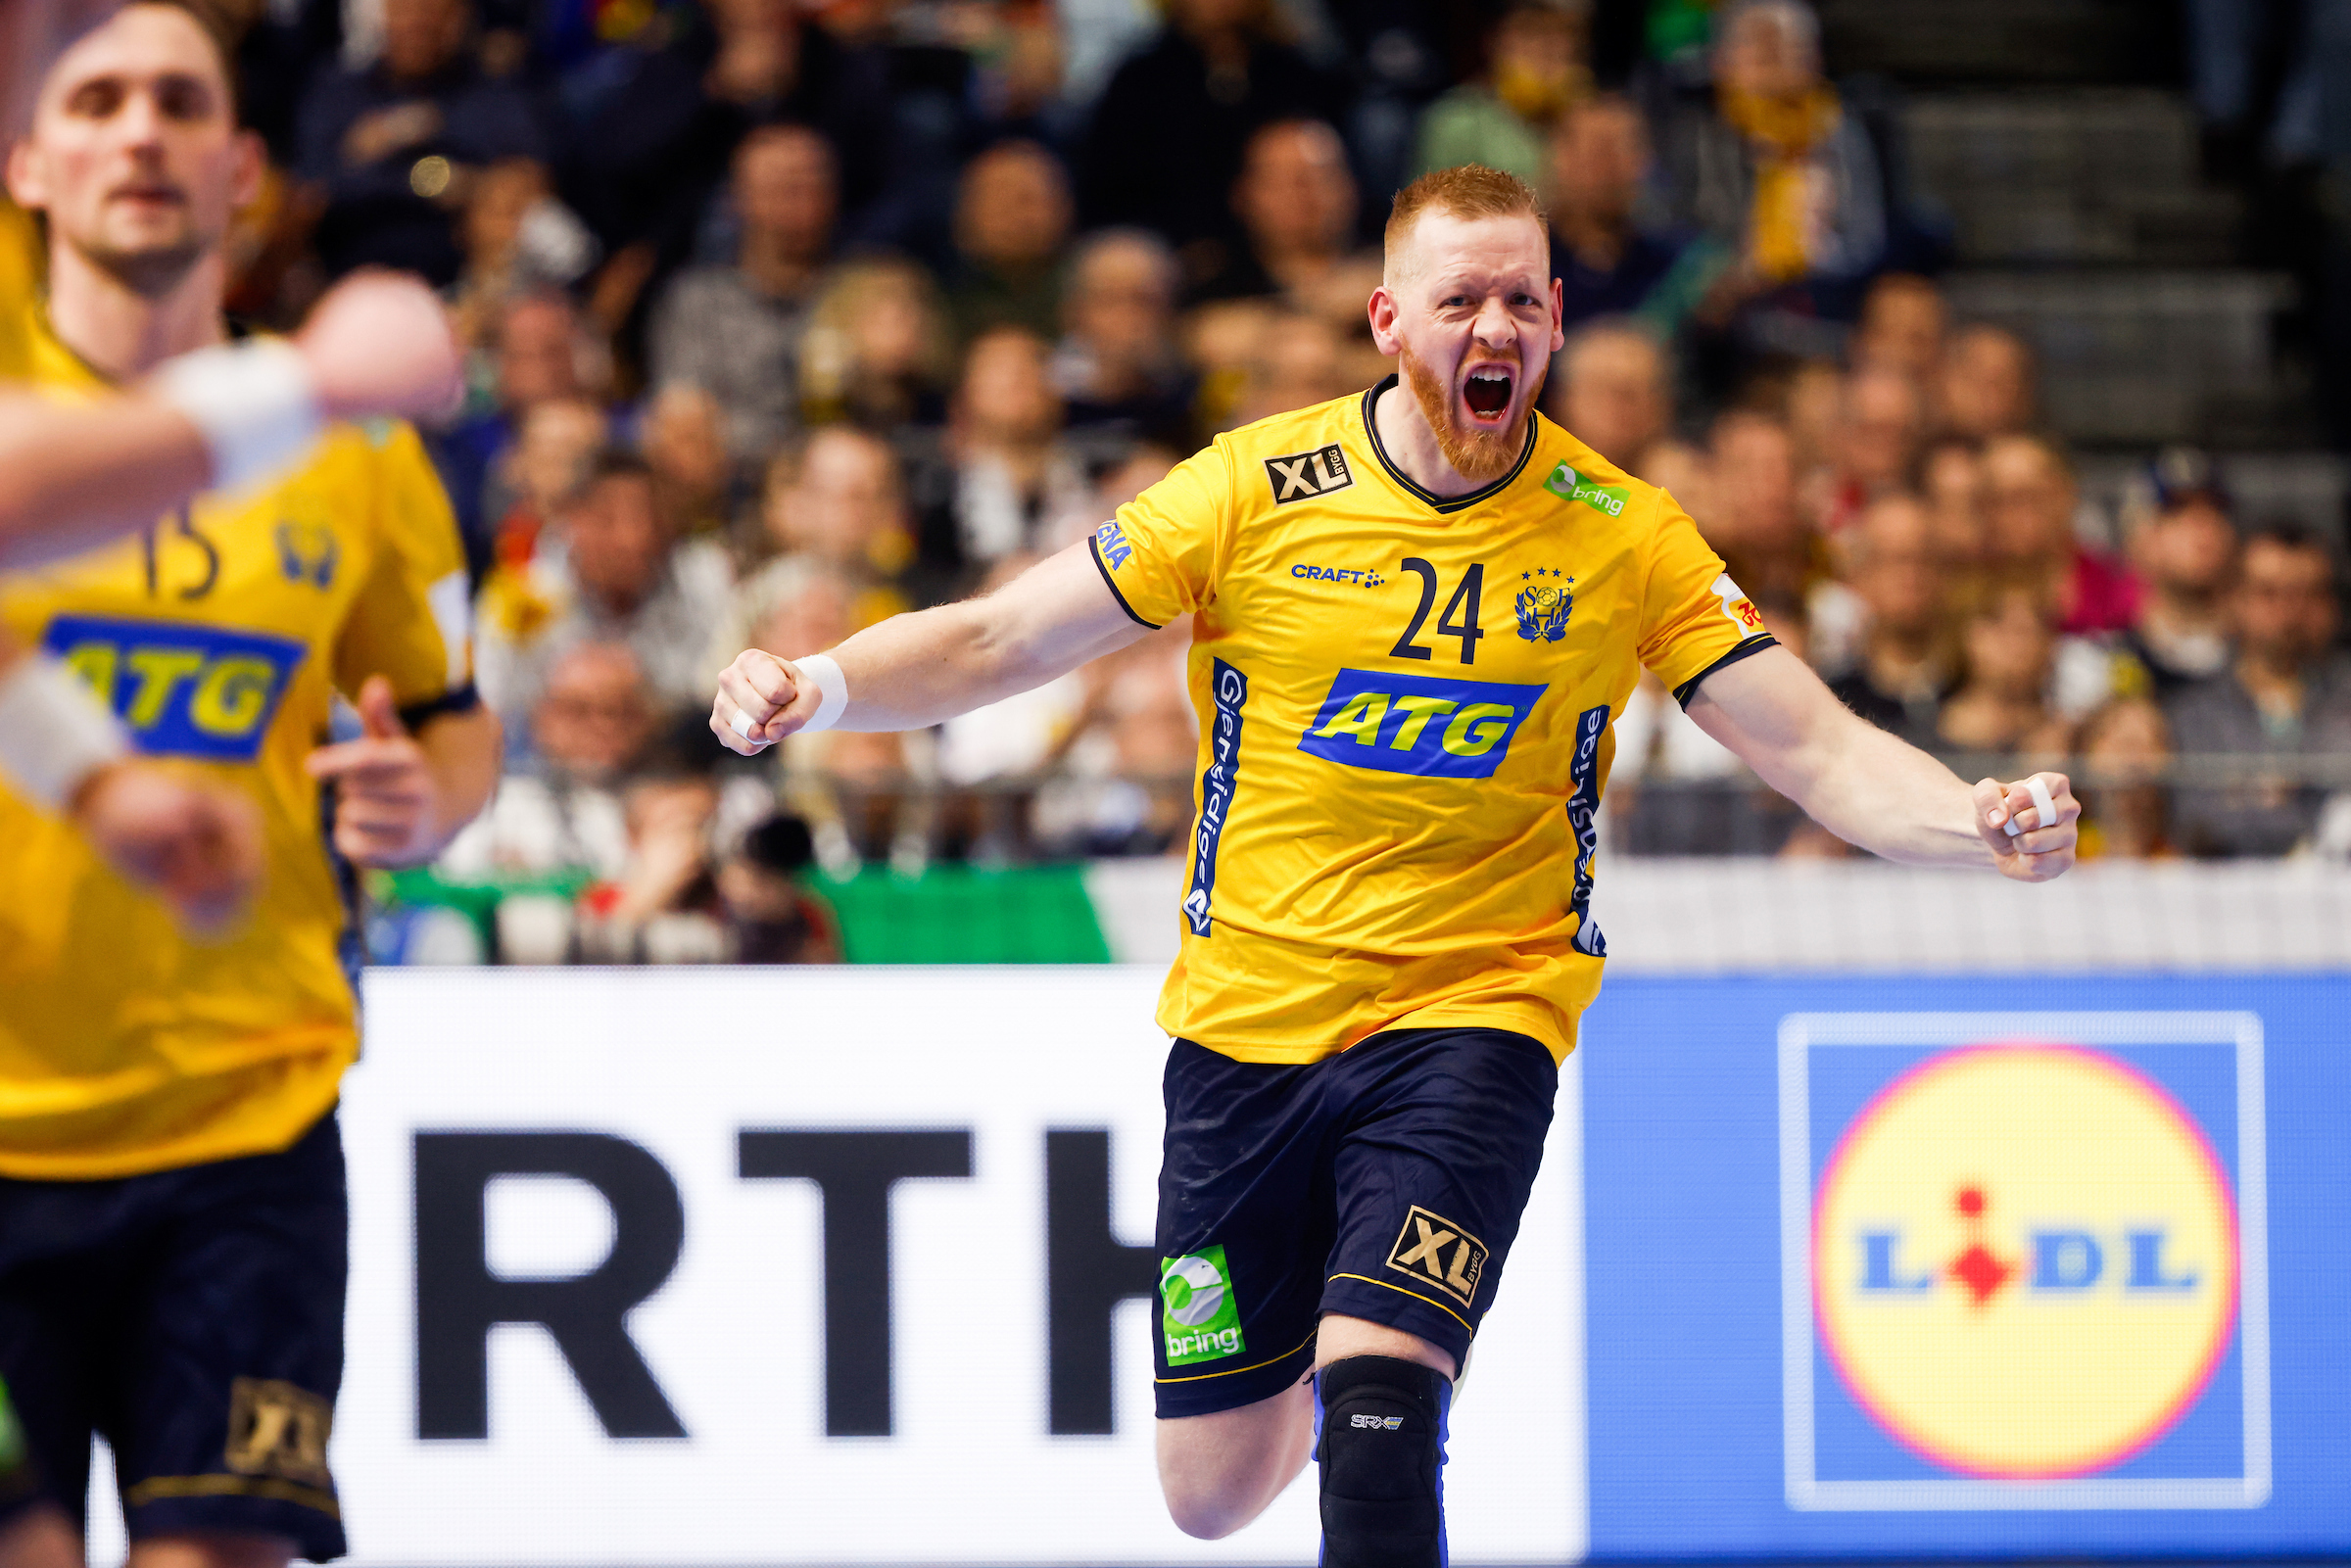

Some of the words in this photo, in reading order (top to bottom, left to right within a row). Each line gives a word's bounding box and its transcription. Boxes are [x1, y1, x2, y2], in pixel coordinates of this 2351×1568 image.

[1269, 452, 1349, 500] XL
[1327, 449, 1345, 475] BYGG
[1572, 486, 1625, 516] bring
[1291, 564, 1365, 585] CRAFT
[1389, 557, 1484, 665] 24
[1312, 691, 1515, 757] ATG
[1395, 1216, 1473, 1296] XL
[1467, 1250, 1482, 1284] BYGG
[1167, 1326, 1239, 1357] bring
